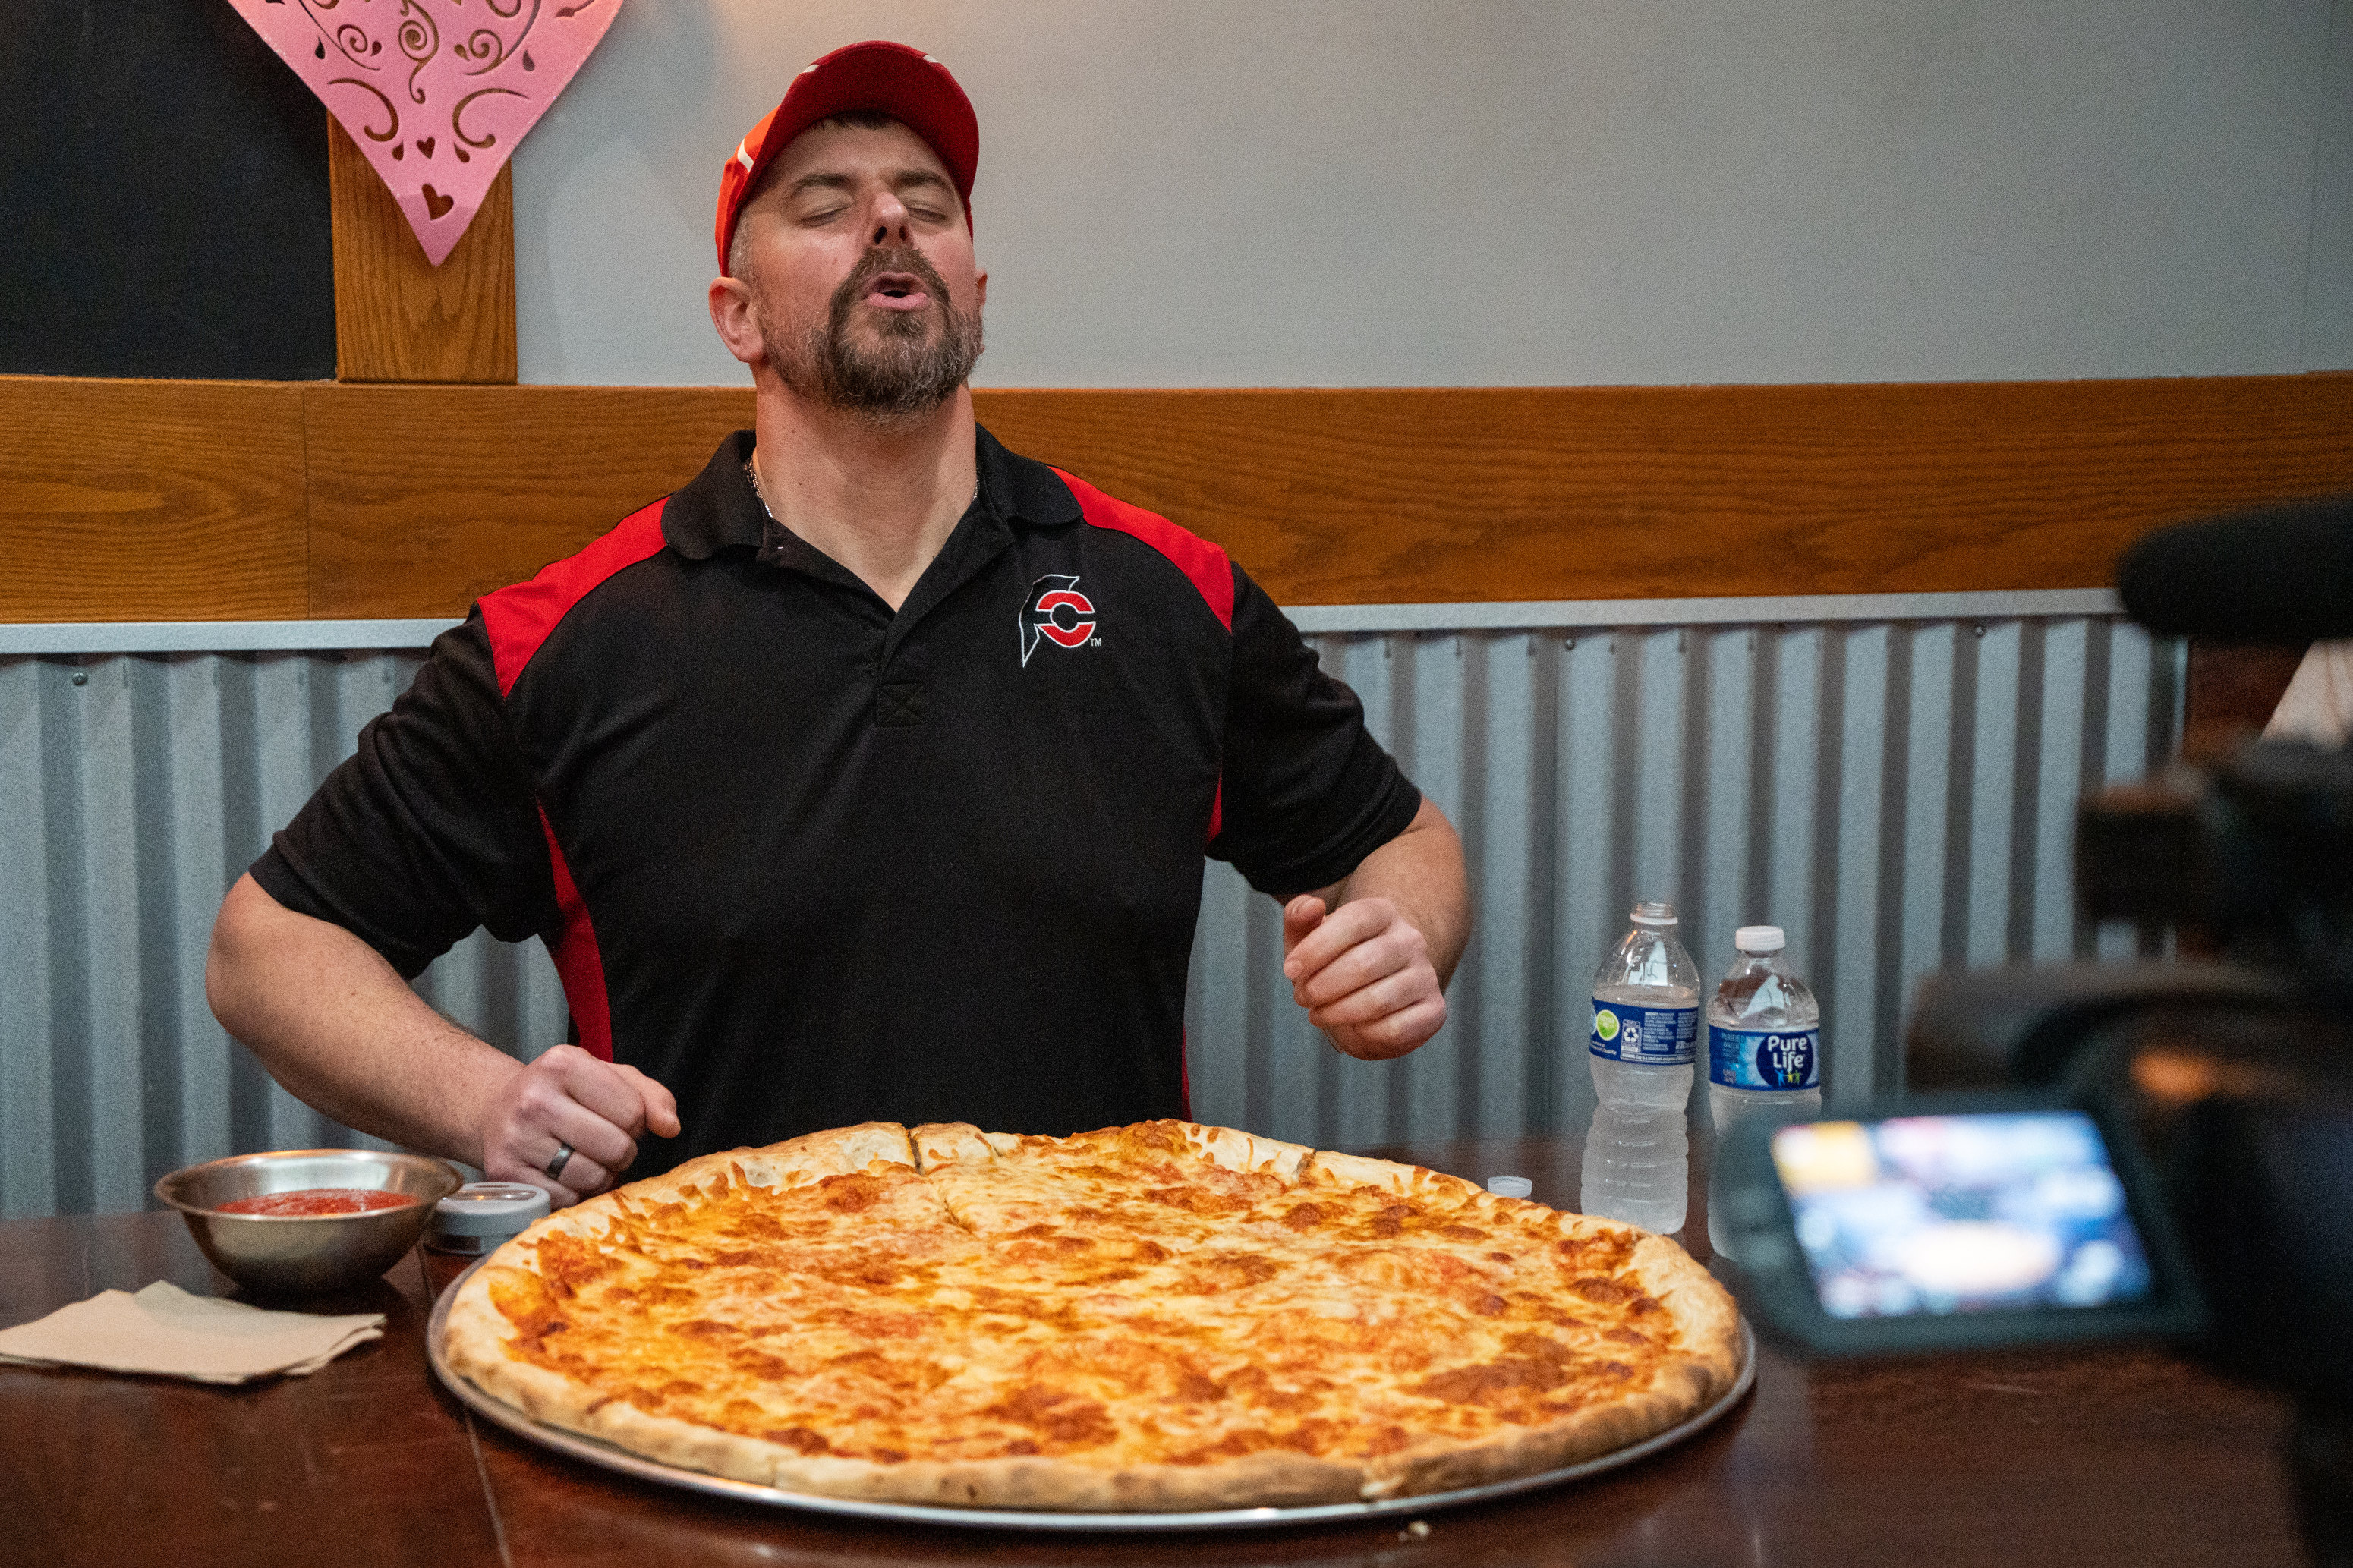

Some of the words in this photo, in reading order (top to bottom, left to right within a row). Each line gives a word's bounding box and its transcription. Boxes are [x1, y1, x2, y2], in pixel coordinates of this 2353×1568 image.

[1090, 638, 1102, 647] TM
[1767, 1035, 1808, 1052] Pure
[1772, 1051, 1805, 1072] Life
